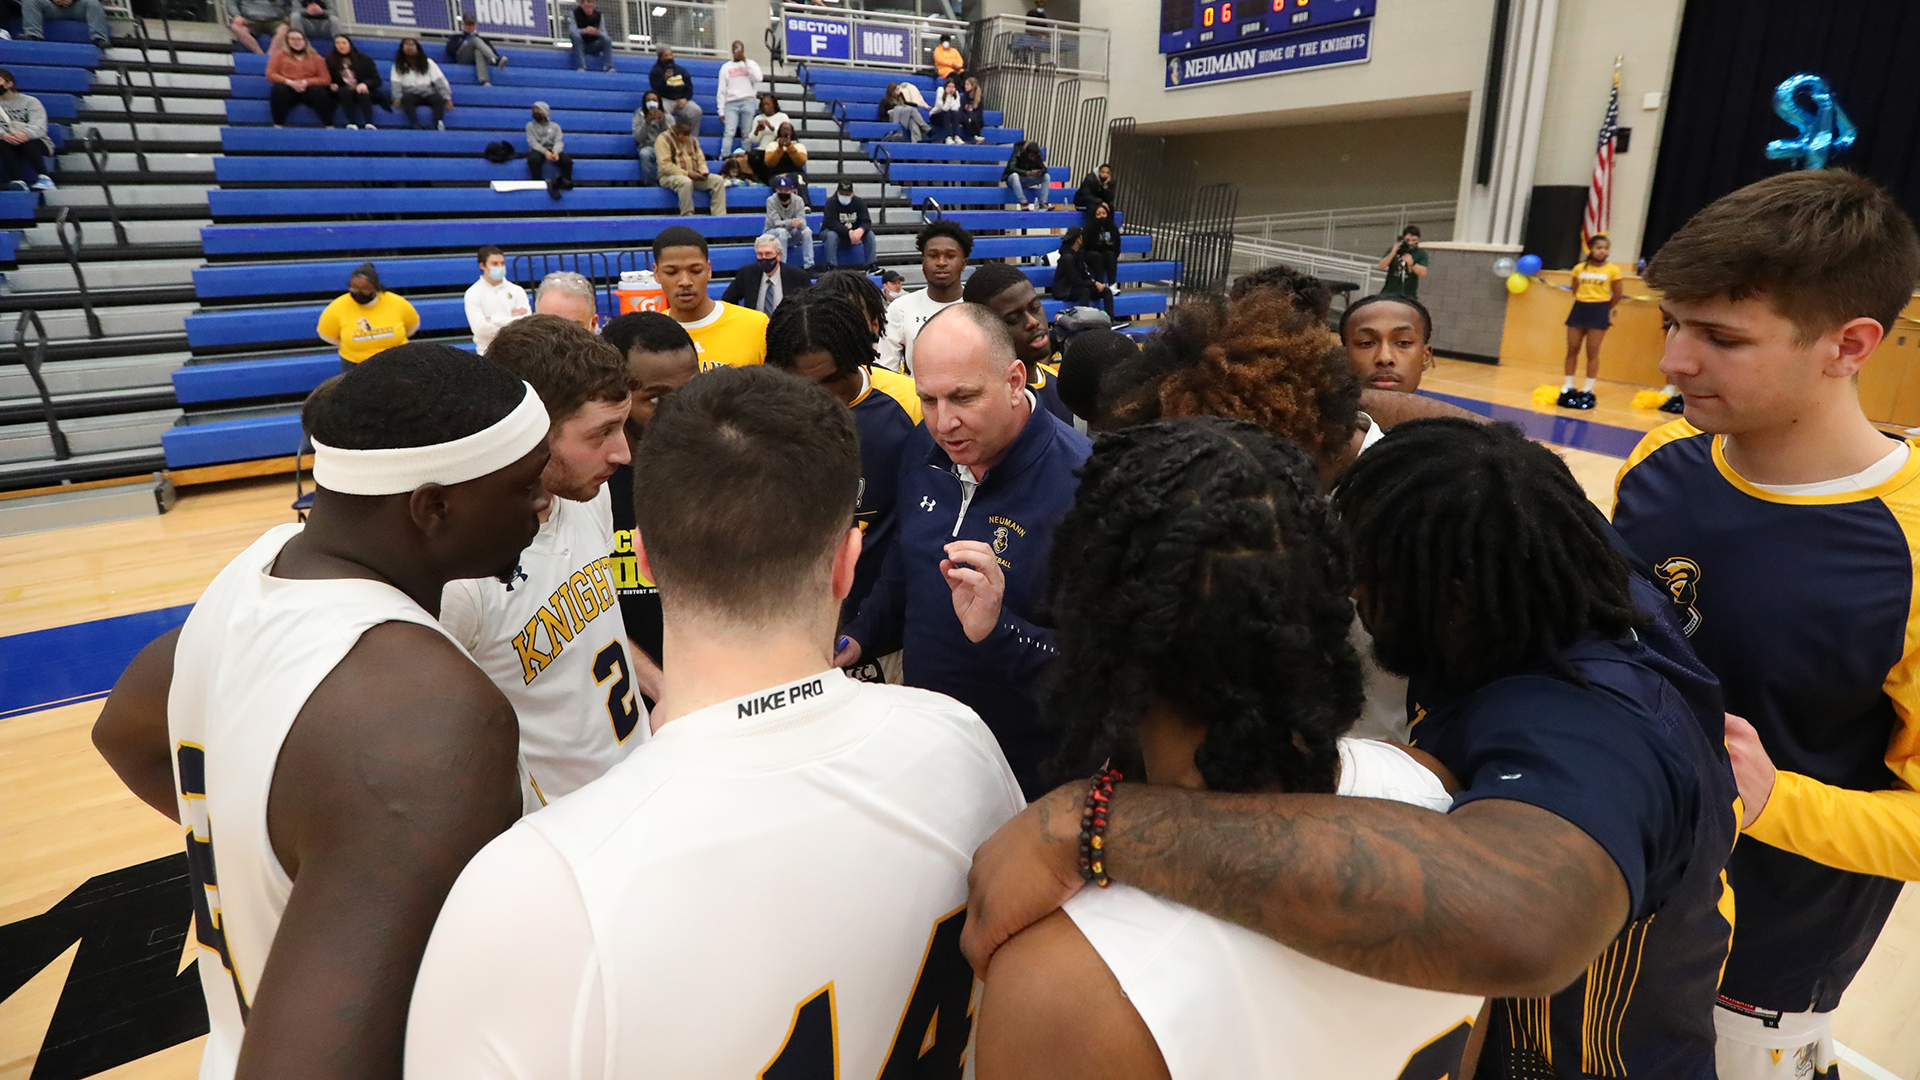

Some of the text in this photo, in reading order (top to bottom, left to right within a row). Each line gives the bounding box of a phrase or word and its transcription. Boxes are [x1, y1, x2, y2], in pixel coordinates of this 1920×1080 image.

[475, 0, 535, 27] HOME
[788, 19, 848, 36] SECTION
[810, 34, 828, 54] F
[863, 31, 904, 57] HOME
[1184, 33, 1366, 79] NEUMANN HOME OF THE KNIGHTS
[988, 515, 1027, 538] NEUMANN
[591, 638, 640, 746] 2
[737, 678, 824, 720] NIKE PRO
